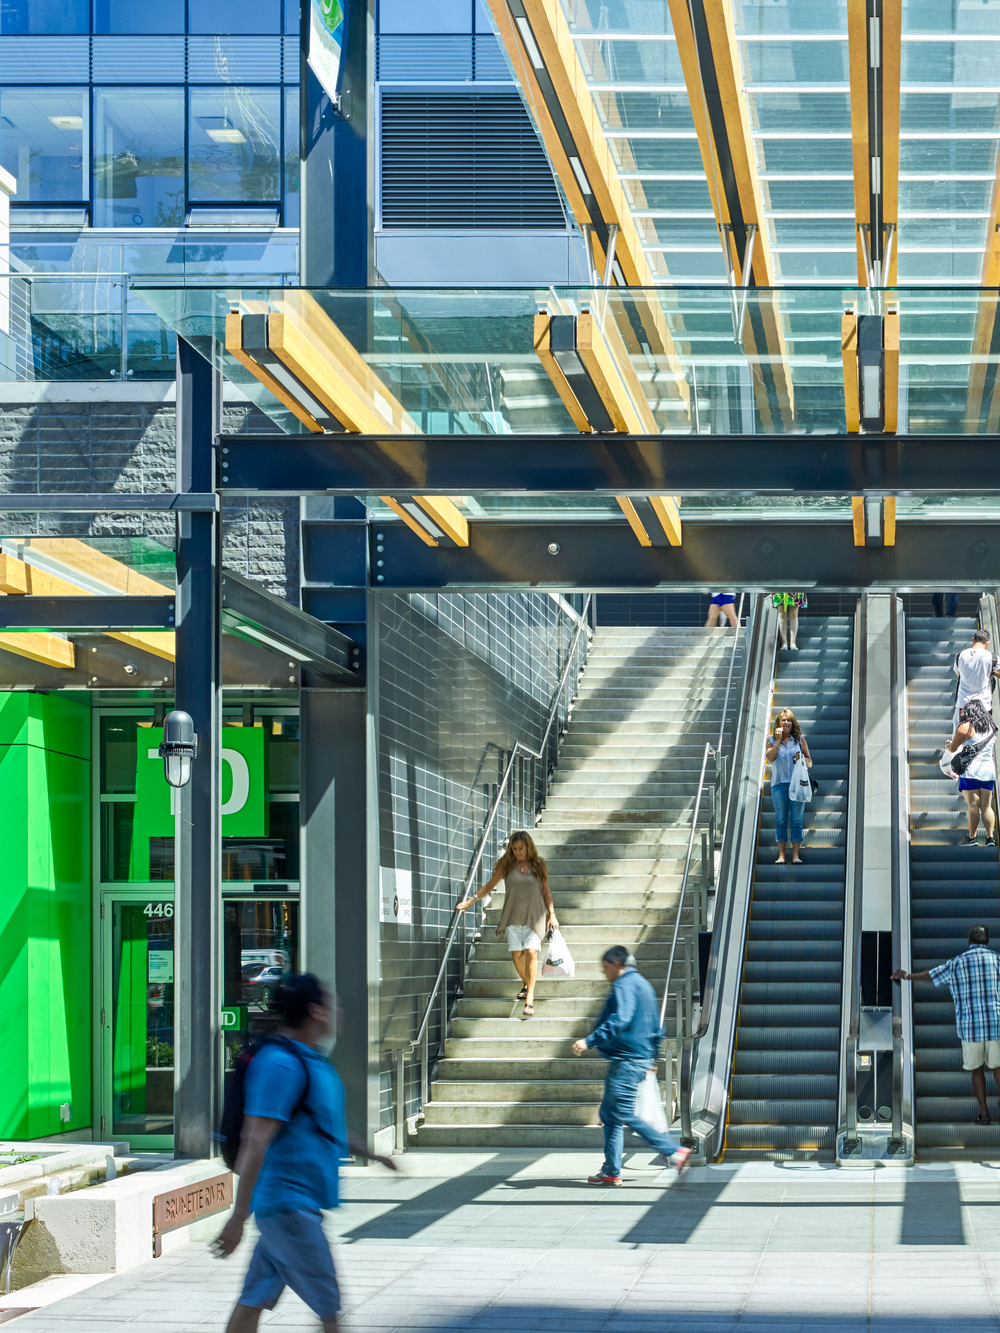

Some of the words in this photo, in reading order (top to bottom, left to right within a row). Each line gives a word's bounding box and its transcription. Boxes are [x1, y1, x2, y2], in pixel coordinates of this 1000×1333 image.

[143, 903, 174, 917] 446
[165, 1189, 203, 1222] BRUNETTE
[206, 1182, 225, 1207] RIVER
